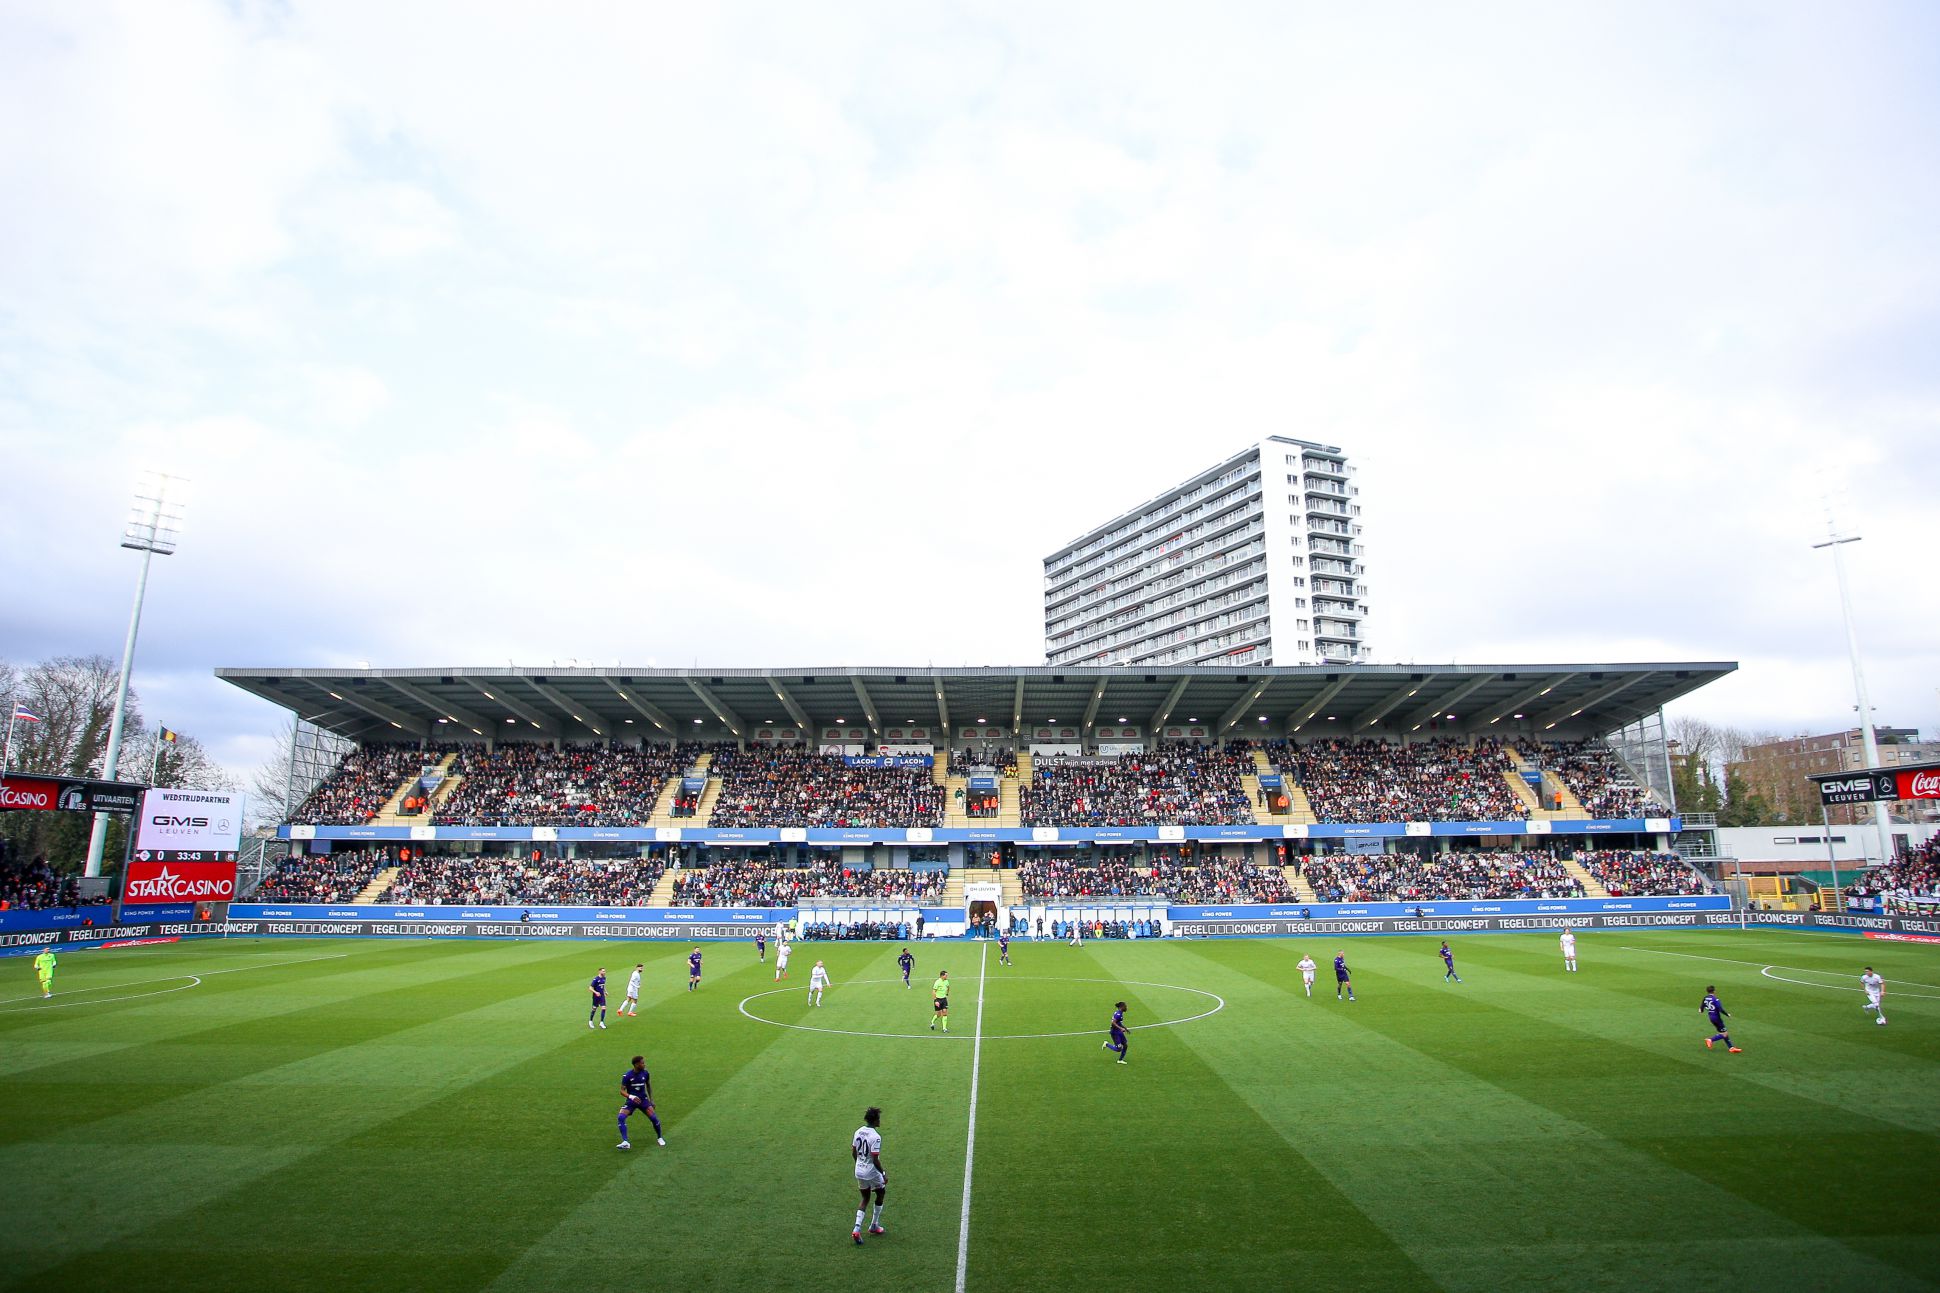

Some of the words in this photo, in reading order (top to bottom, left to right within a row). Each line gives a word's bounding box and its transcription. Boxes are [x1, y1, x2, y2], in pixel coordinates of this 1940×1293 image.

[1034, 758, 1064, 766] DULST
[1096, 758, 1116, 766] advies
[1821, 778, 1870, 794] GMS
[5, 792, 48, 806] CASINO
[93, 794, 134, 805] UITVAARTEN
[162, 794, 230, 804] WEDSTRIJDPARTNER
[1830, 794, 1865, 802] LEUVEN
[152, 816, 208, 827] GMS
[158, 851, 164, 860] 0
[177, 852, 201, 860] 33:43
[214, 852, 219, 860] 1
[1498, 919, 1527, 929] TEGEL
[1552, 917, 1593, 927] CONCEPT
[1602, 916, 1631, 926] TEGEL
[1655, 914, 1696, 925] CONCEPT
[1705, 914, 1733, 923] TEGEL
[1758, 914, 1804, 924] CONCEPT
[1814, 915, 1836, 925] TEGEL
[1857, 916, 1892, 929] CONCEPT
[160, 924, 189, 934] TEGEL
[217, 923, 258, 933] CONCEPT
[268, 923, 295, 933] TEGEL
[321, 924, 362, 934] CONCEPT
[372, 924, 399, 934] TEGEL
[425, 925, 467, 935] CONCEPT
[531, 926, 573, 936] CONCEPT
[583, 926, 611, 936] TEGEL
[638, 927, 680, 936] CONCEPT
[1178, 925, 1207, 934] TEGEL
[1234, 923, 1277, 934] CONCEPT
[1286, 923, 1315, 933] TEGEL
[1342, 922, 1384, 932] CONCEPT
[1393, 921, 1421, 931] TEGEL
[1900, 920, 1928, 931] TEGEL
[69, 930, 93, 941] TEGEL
[116, 926, 150, 937] CONCEPT
[689, 927, 718, 937] TEGEL
[19, 932, 61, 945] CONCEPT
[1704, 1000, 1715, 1010] 36
[856, 1136, 869, 1157] 20
